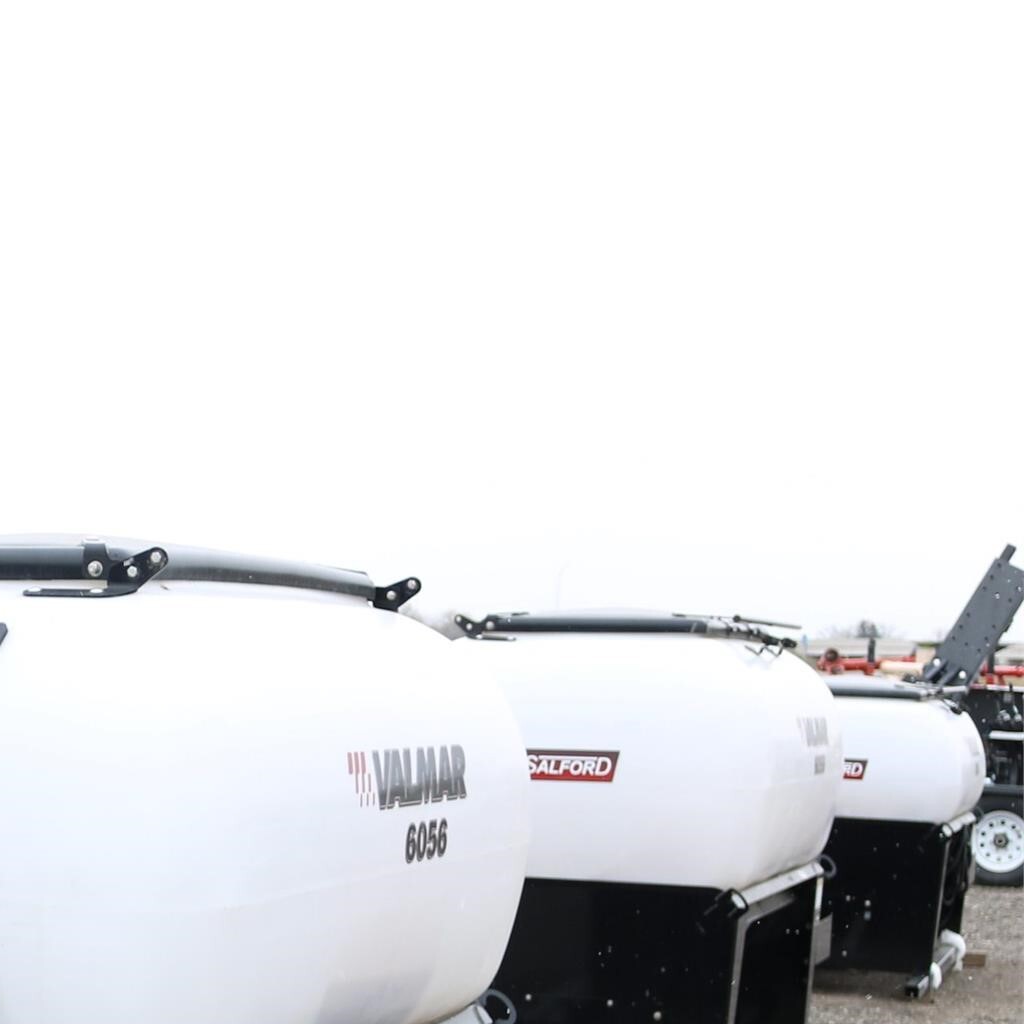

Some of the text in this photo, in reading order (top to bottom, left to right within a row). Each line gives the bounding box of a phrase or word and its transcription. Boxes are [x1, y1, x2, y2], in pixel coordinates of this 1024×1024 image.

[372, 744, 467, 811] VALMAR
[527, 754, 612, 776] SALFORD
[405, 817, 448, 864] 6056
